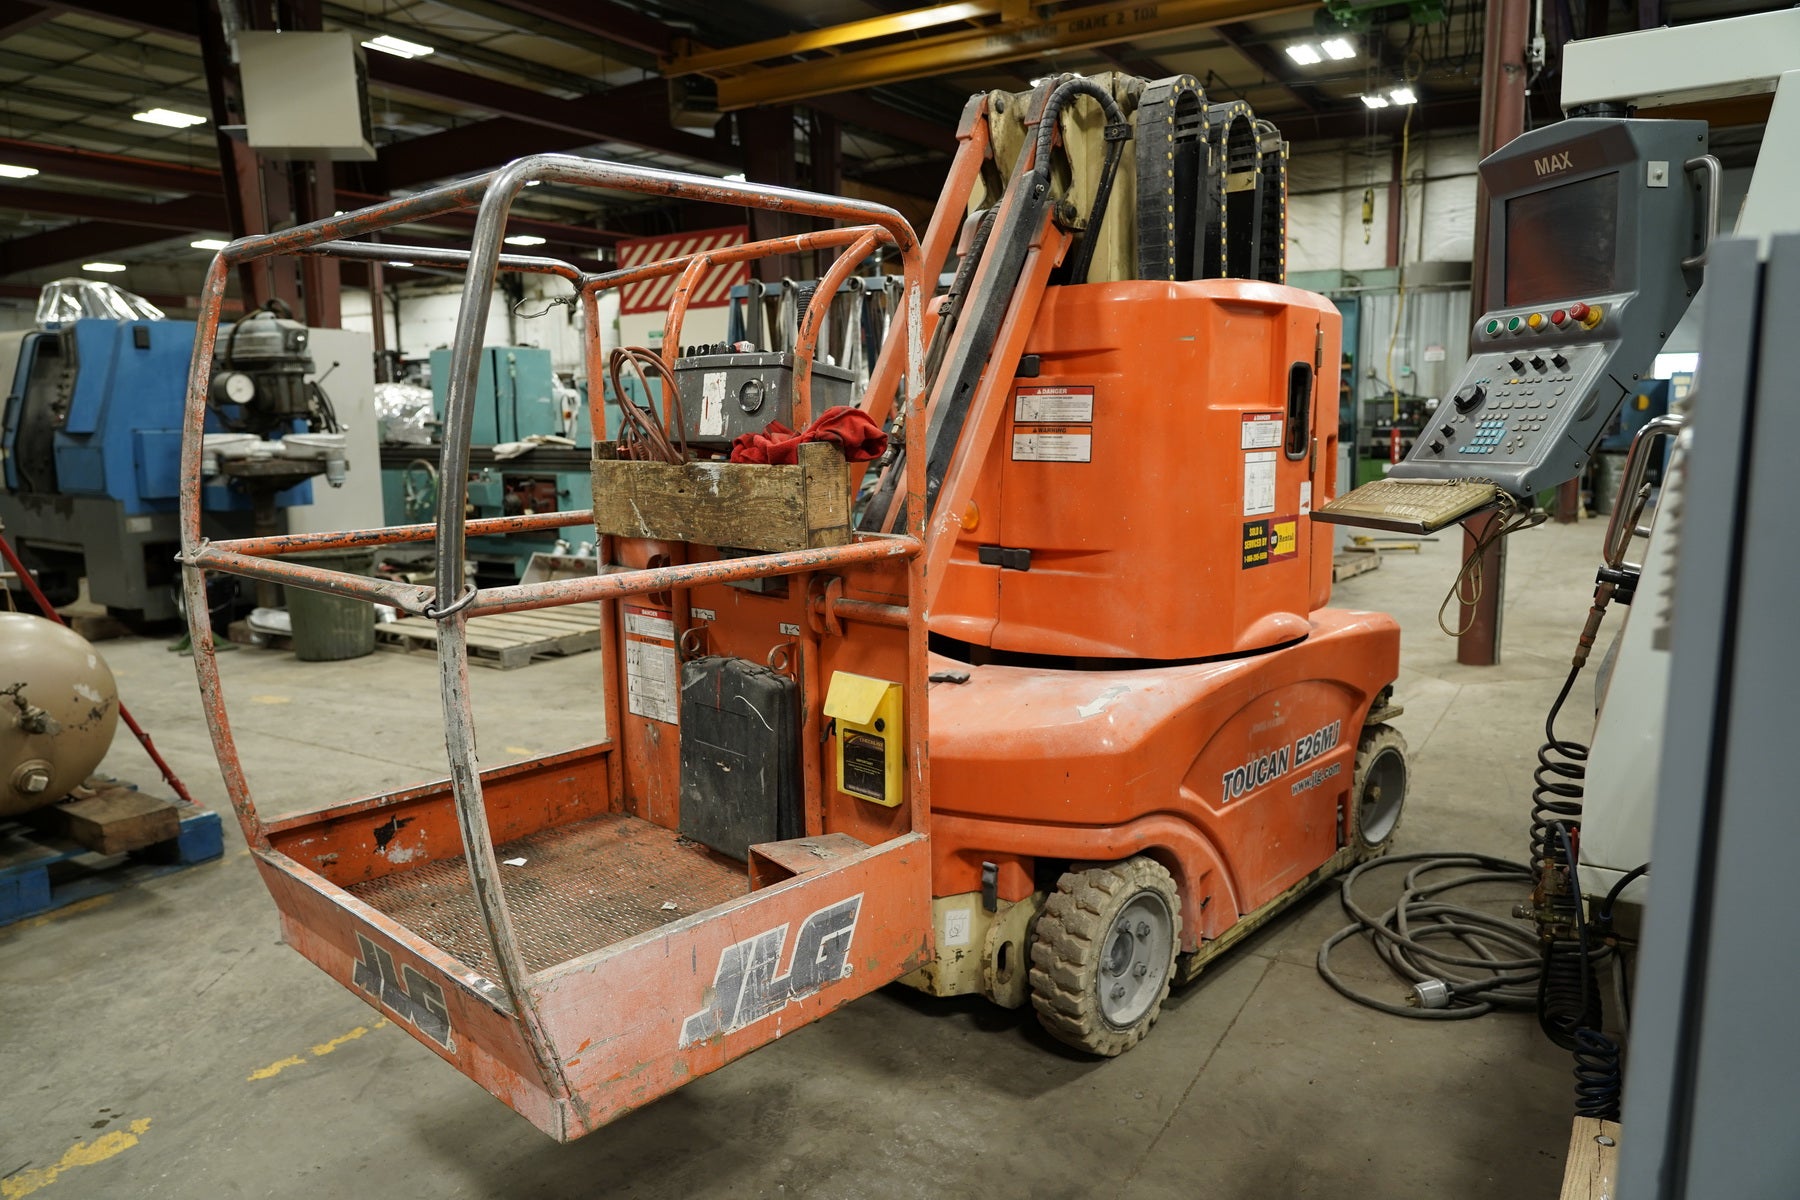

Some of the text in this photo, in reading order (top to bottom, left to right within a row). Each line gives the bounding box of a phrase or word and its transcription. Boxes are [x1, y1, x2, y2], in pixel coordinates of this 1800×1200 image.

[1068, 6, 1158, 33] CRANE 2 TON
[1534, 151, 1573, 176] MAX
[1249, 526, 1259, 536] SOLD
[1279, 532, 1294, 543] Rental
[1244, 537, 1268, 550] SERVICED BY
[641, 609, 658, 617] DANGER
[1222, 719, 1341, 804] TOUCAN E26MJ
[1291, 762, 1341, 797] www.jlg.com
